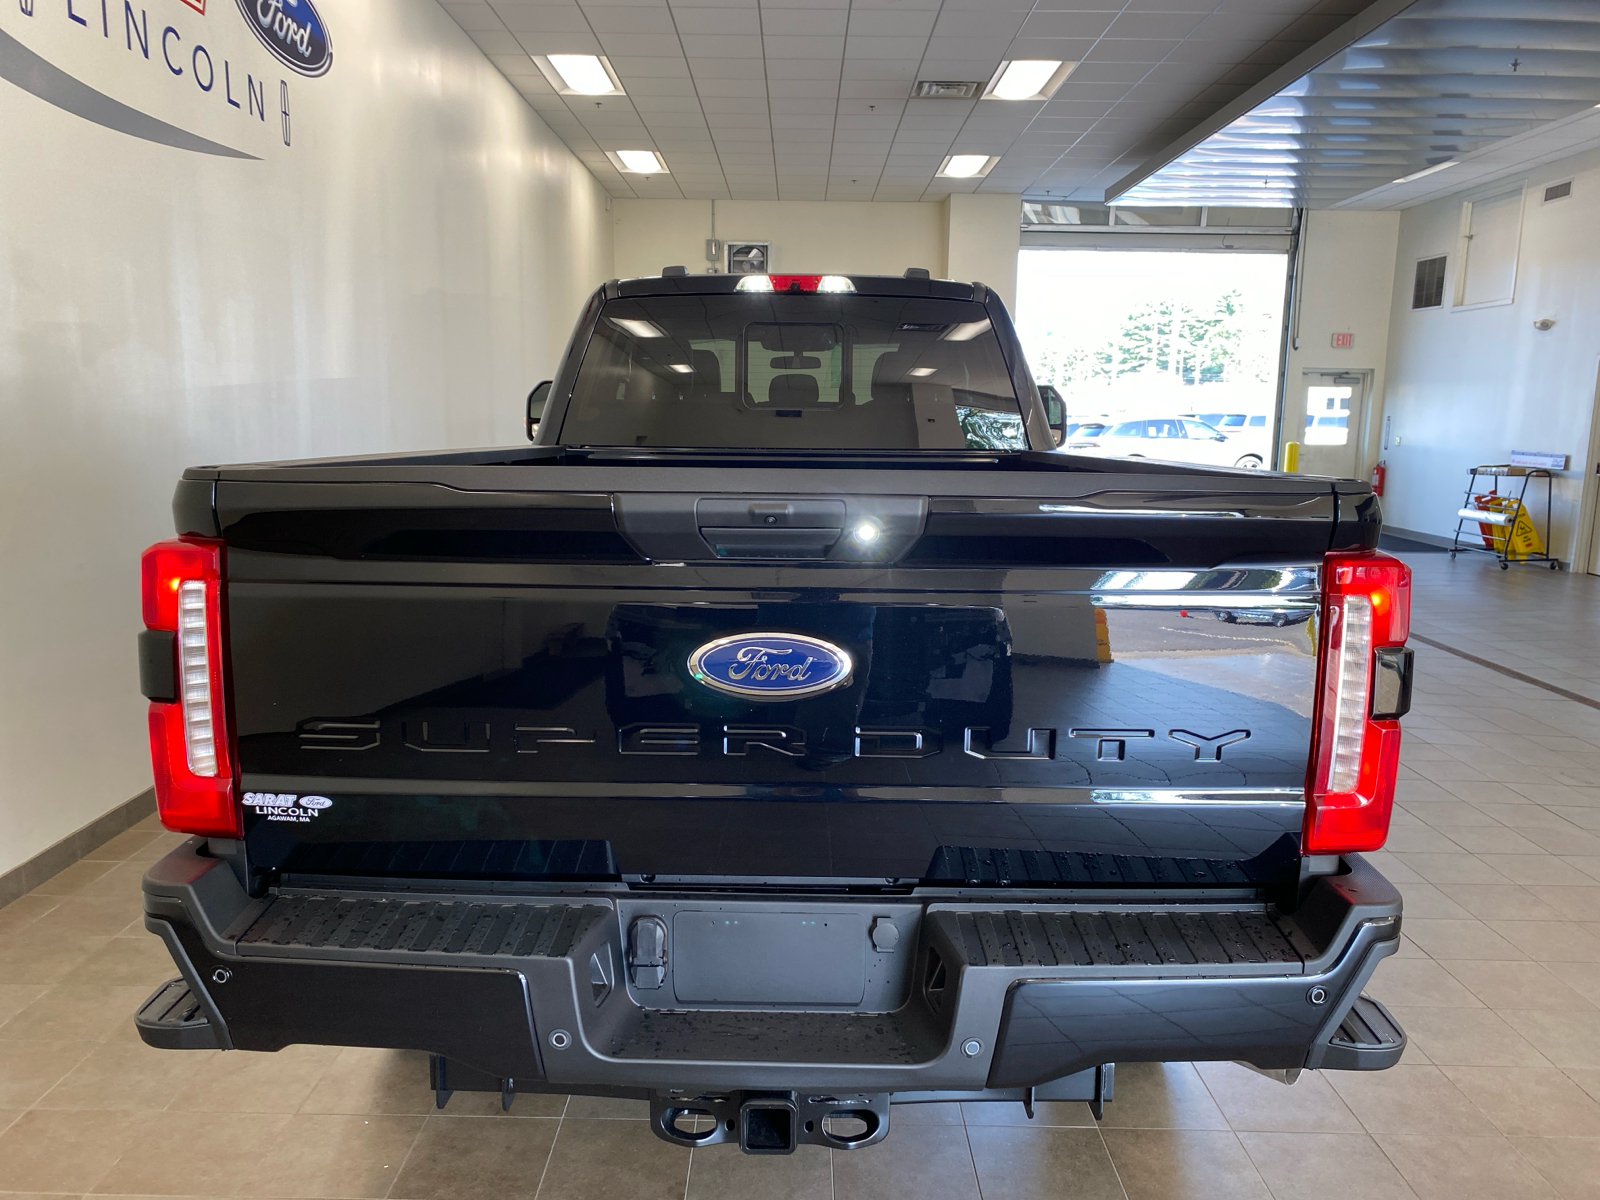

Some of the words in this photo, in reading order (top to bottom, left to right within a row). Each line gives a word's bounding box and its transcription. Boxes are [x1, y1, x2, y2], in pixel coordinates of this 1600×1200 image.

[257, 0, 312, 58] Ford
[1336, 332, 1353, 347] EXIT
[728, 646, 812, 681] Ford
[296, 716, 807, 757] SUPER
[854, 725, 1252, 762] DUTY
[242, 792, 297, 807] SARAT
[255, 806, 319, 817] LINCOLN
[267, 815, 299, 823] AGAWAM,
